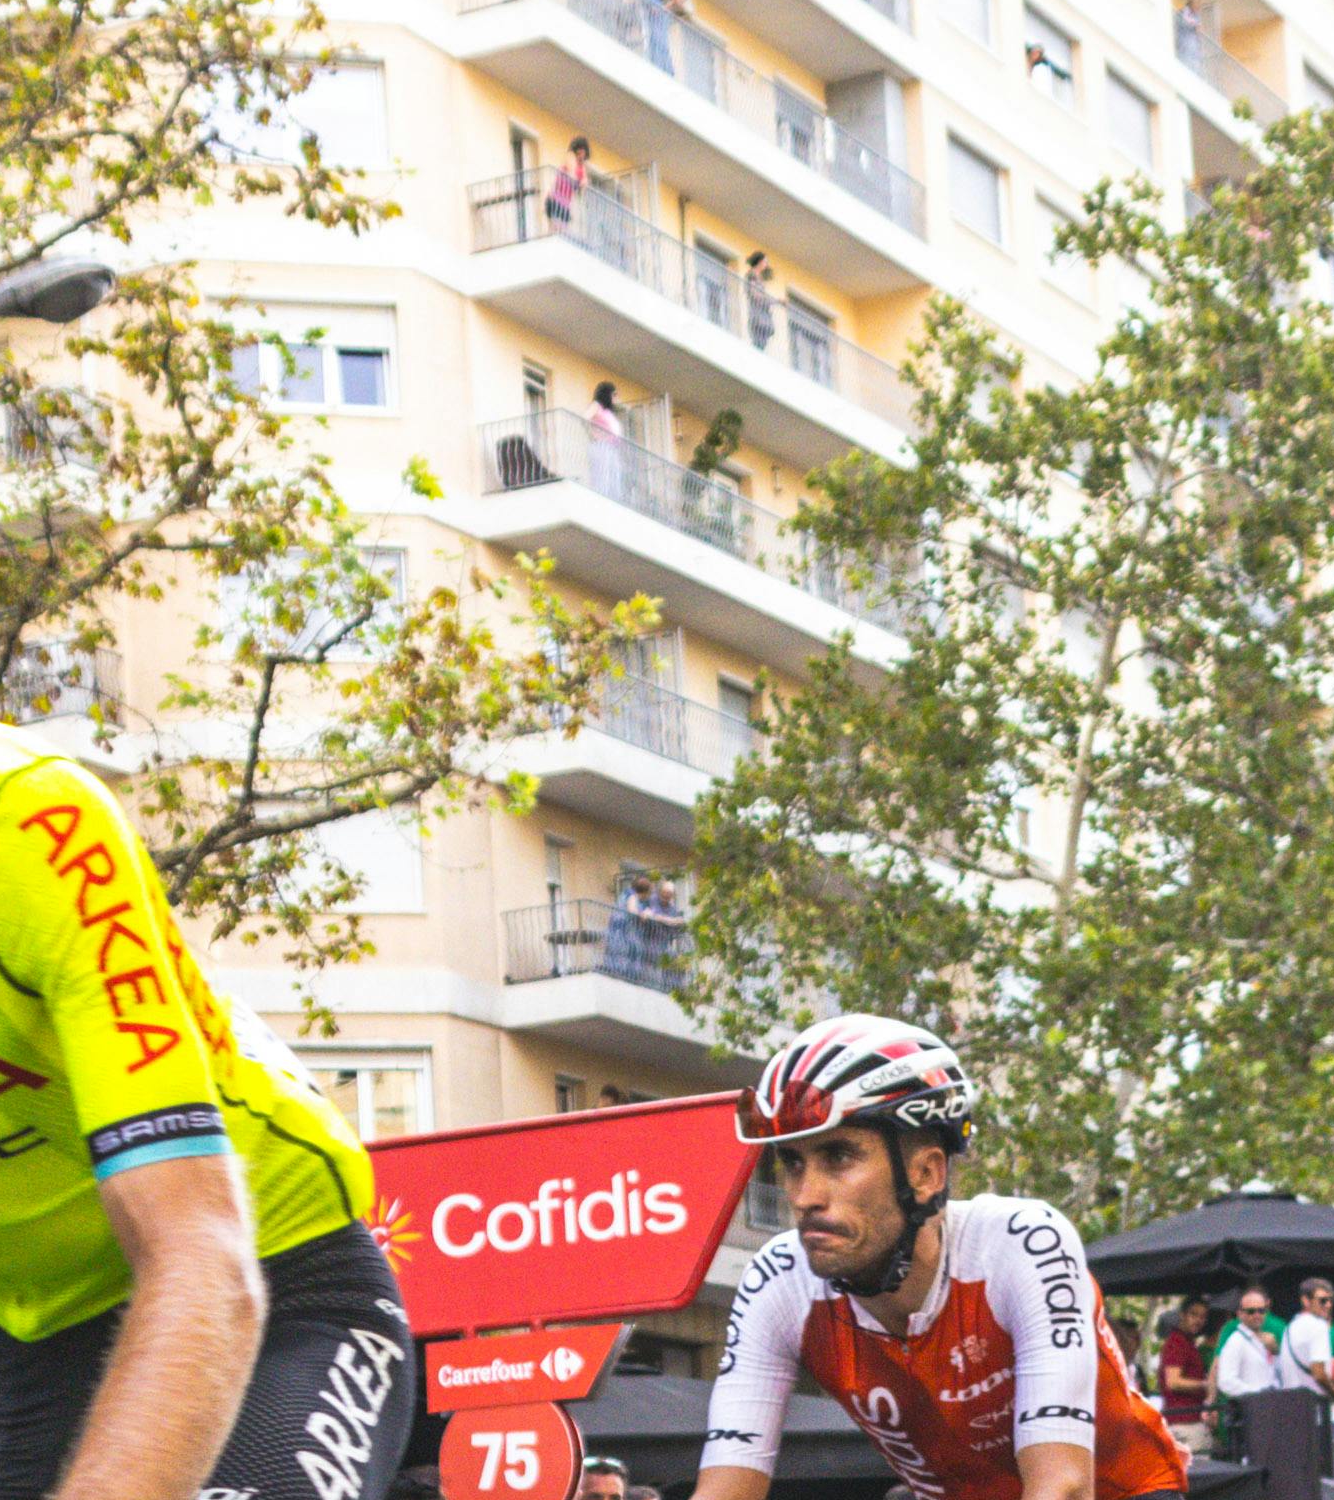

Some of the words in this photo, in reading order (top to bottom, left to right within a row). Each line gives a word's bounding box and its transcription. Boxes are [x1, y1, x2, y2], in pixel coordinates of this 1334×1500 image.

[19, 804, 182, 1076] ARKEA
[858, 1061, 914, 1092] Cofidis
[432, 1168, 688, 1258] Cofidis
[1007, 1206, 1084, 1350] Cofidis
[438, 1357, 534, 1388] Carrefour
[470, 1430, 539, 1491] 75
